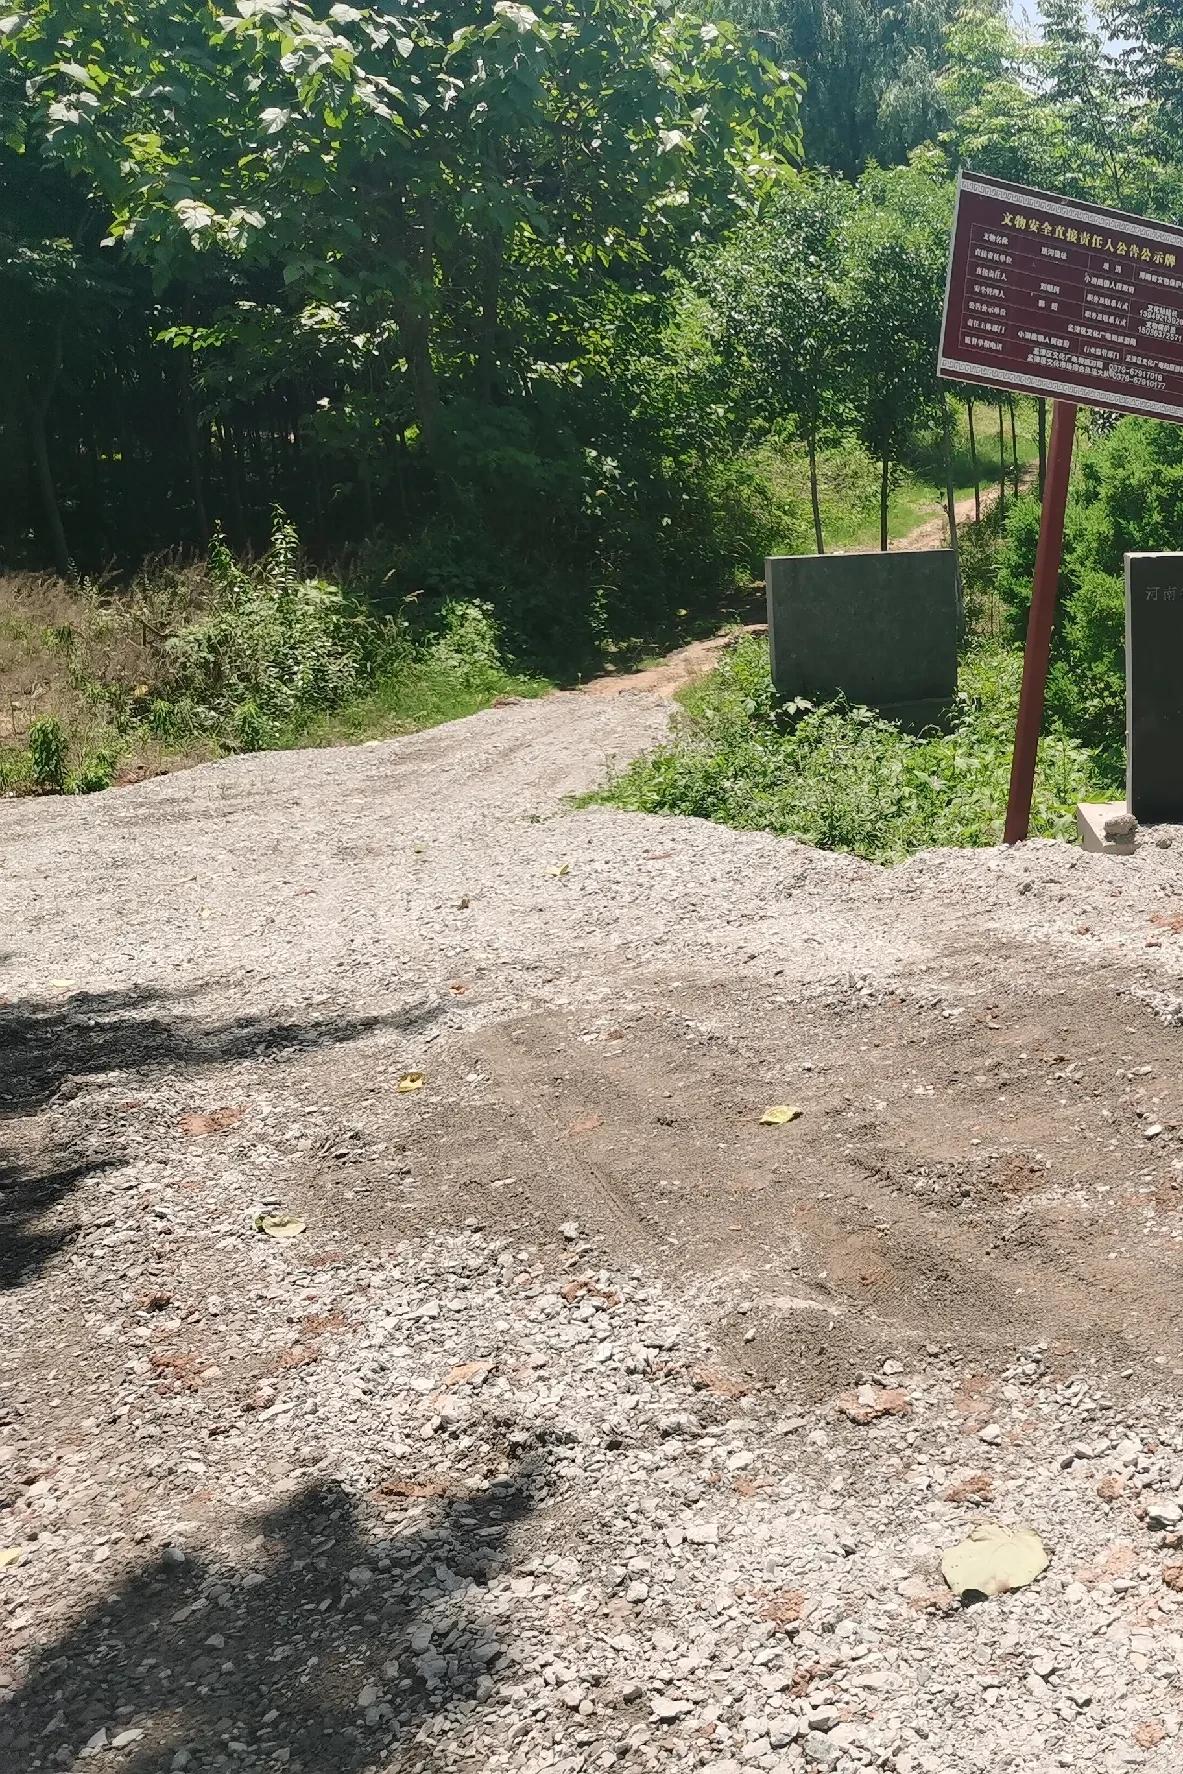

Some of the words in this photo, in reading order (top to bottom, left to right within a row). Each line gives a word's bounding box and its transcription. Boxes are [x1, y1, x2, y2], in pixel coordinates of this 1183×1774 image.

[1000, 209, 1177, 269] 文物安全直接责任人公告公示牌
